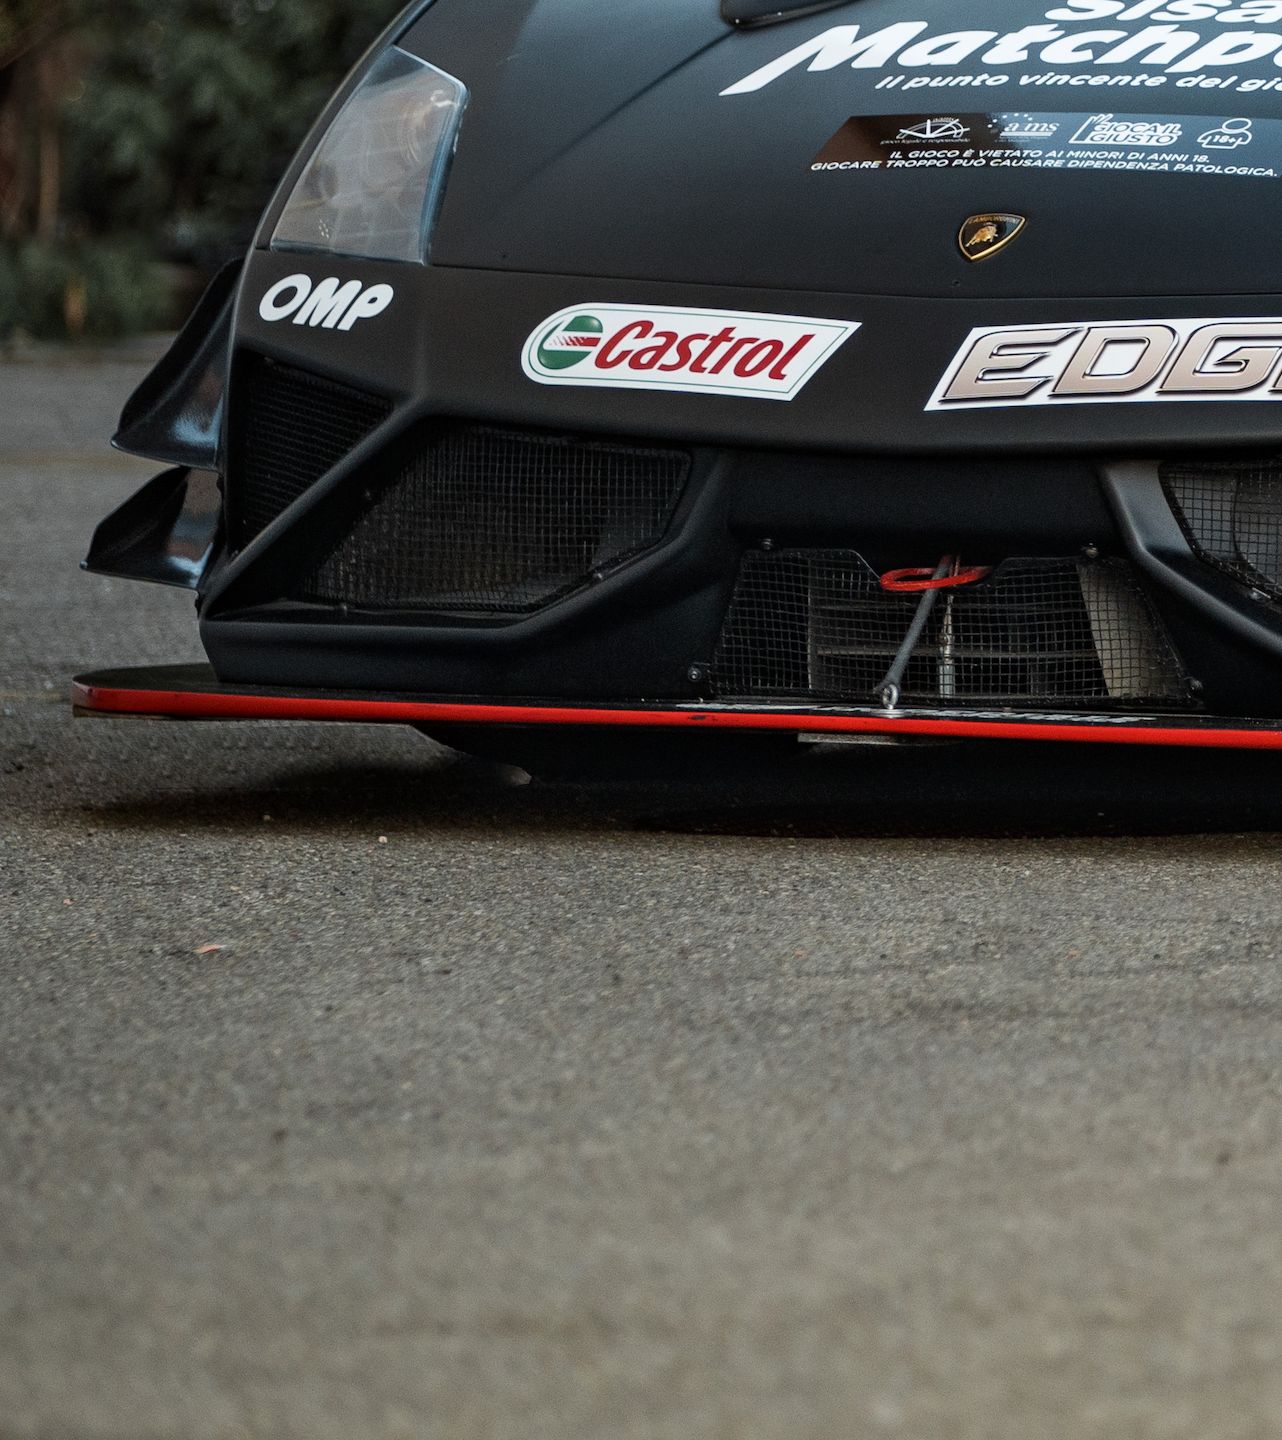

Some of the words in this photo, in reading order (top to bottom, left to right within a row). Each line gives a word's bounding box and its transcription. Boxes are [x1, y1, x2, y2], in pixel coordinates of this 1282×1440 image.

[901, 73, 1010, 91] punto
[1019, 72, 1168, 87] vincente
[1175, 74, 1239, 88] del
[890, 150, 904, 159] IL
[908, 149, 960, 159] GIOCO
[962, 148, 975, 158] È
[978, 149, 1044, 158] VIETATO
[1048, 149, 1064, 158] AI
[1066, 150, 1126, 160] MINORI
[1126, 151, 1144, 160] DI
[1147, 152, 1190, 162] ANNI
[1192, 154, 1210, 163] 18.
[810, 161, 882, 171] GIOCARE
[886, 159, 949, 169] TROPPO
[951, 157, 986, 168] PUÒ
[989, 158, 1064, 168] CAUSARE
[1067, 159, 1169, 171] DIPENDENZA
[1173, 162, 1278, 177] PATOLOGICA.
[259, 274, 394, 331] OMP
[594, 320, 807, 380] Castrol
